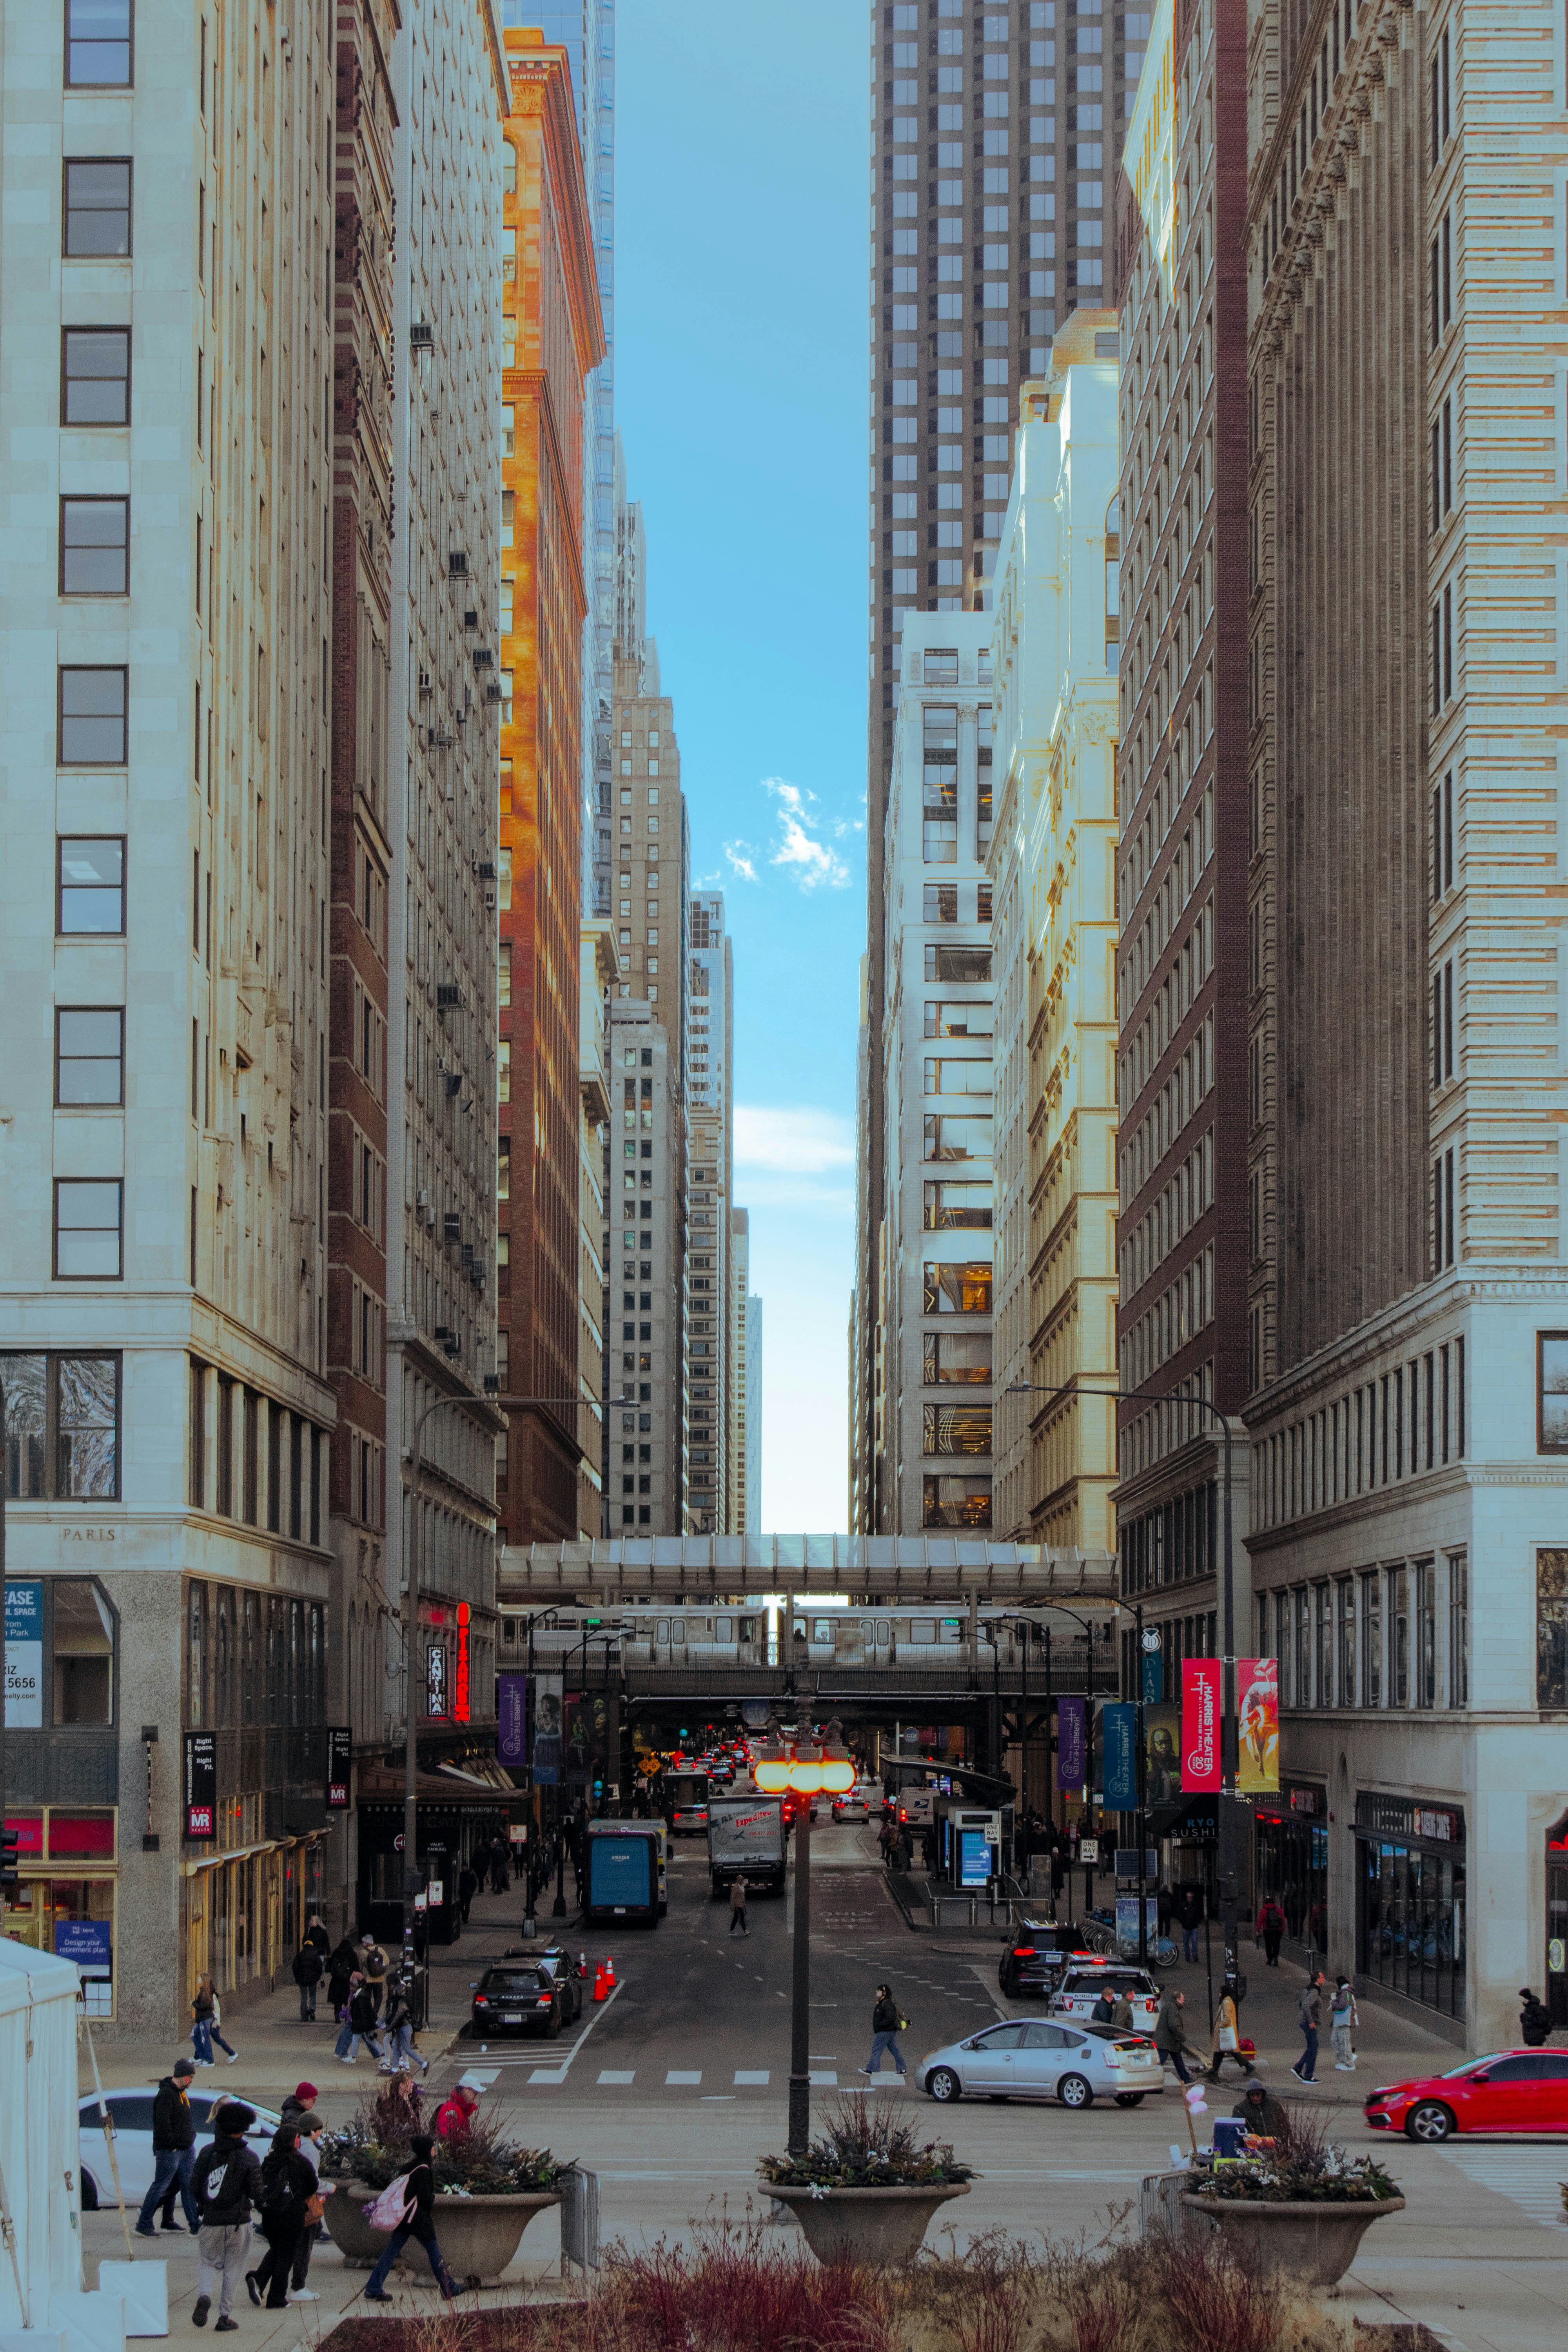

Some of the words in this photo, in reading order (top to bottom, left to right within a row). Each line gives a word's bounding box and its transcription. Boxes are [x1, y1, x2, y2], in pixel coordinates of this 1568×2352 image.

[64, 1528, 115, 1541] PARIS
[431, 1649, 442, 1712] CANTINA
[1204, 1686, 1213, 1726] HARRIS
[1204, 1726, 1213, 1771] THEATER
[1196, 1757, 1203, 1769] 20
[1121, 1758, 1129, 1793] THEATER
[331, 1789, 345, 1799] MR
[191, 1813, 209, 1827] MR
[1187, 1818, 1214, 1827] RYO
[1171, 1828, 1215, 1838] SUSHI
[65, 1938, 85, 1947] Design
